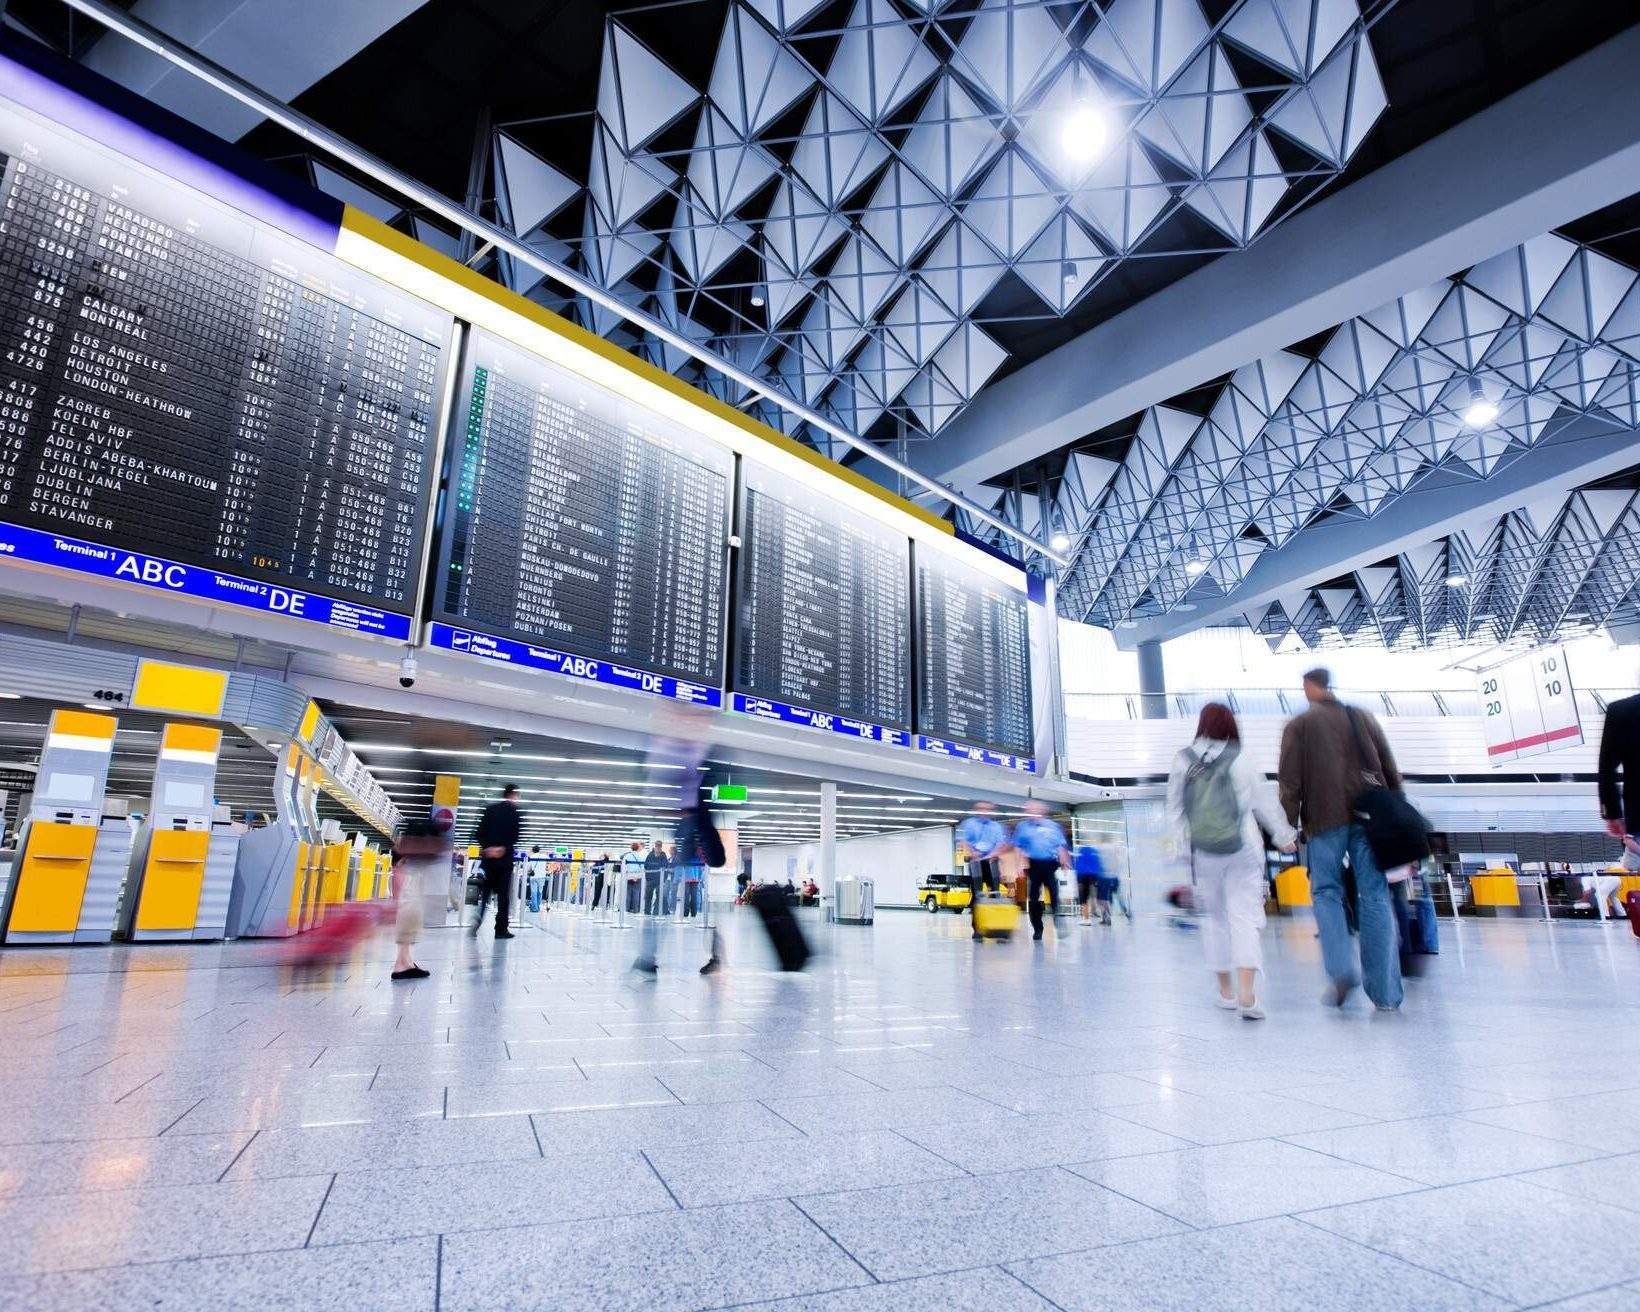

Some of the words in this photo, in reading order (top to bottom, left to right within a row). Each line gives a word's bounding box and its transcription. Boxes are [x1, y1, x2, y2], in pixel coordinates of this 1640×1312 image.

[104, 214, 169, 248] HELSINKI
[108, 203, 173, 238] VARADERO
[98, 237, 139, 260] MIAMI
[101, 225, 167, 260] PORTLAND
[34, 290, 60, 308] 875
[80, 308, 147, 340] MONTREAL
[83, 296, 144, 325] CALGARY
[24, 329, 51, 345] 442
[70, 345, 131, 372] DETROIT
[27, 316, 54, 333] 456
[73, 332, 100, 349] LOS
[108, 345, 168, 373] ANGELES
[20, 342, 47, 358] 440
[66, 357, 129, 385] HOUSTON
[6, 352, 43, 371] 4726
[64, 369, 192, 420] LONDON-HEATHROW
[9, 381, 37, 396] 417
[57, 395, 111, 419] ZAGREB
[2, 406, 30, 422] 686
[51, 421, 75, 437] TEL
[87, 433, 122, 450] AVIV
[53, 408, 99, 429] KOELN
[108, 425, 134, 440] HBF
[43, 447, 149, 486] BERLIN-TEGEL
[46, 434, 93, 455] ADDIS
[101, 450, 217, 491] ABEBA-KHARTOUM
[36, 474, 93, 497] DUBLIN
[40, 460, 122, 491] LJUBLJANA
[32, 487, 90, 510] BERGEN
[29, 501, 114, 531] STAVANGER
[525, 523, 557, 539] DETROIT
[54, 539, 108, 560] Terminal
[110, 552, 117, 561] 1
[115, 556, 187, 588] ABC
[214, 576, 259, 594] Terminal
[260, 586, 268, 596] 2
[269, 589, 306, 615] DE
[520, 571, 553, 587] VILNIUS
[517, 591, 555, 608] HELSINKI
[519, 581, 552, 597] TORONTO
[515, 611, 572, 632] POZNAN/POSEN
[516, 601, 559, 619] AMSTERDAM
[514, 621, 544, 635] DUBLIN
[560, 656, 598, 679] ABC
[1541, 657, 1557, 674] 10
[642, 674, 663, 693] DE
[1482, 678, 1498, 695] 20
[1545, 680, 1562, 697] 10
[93, 689, 123, 702] 464
[1486, 700, 1502, 717] 20
[810, 713, 833, 730] ABC
[859, 723, 873, 738] DE
